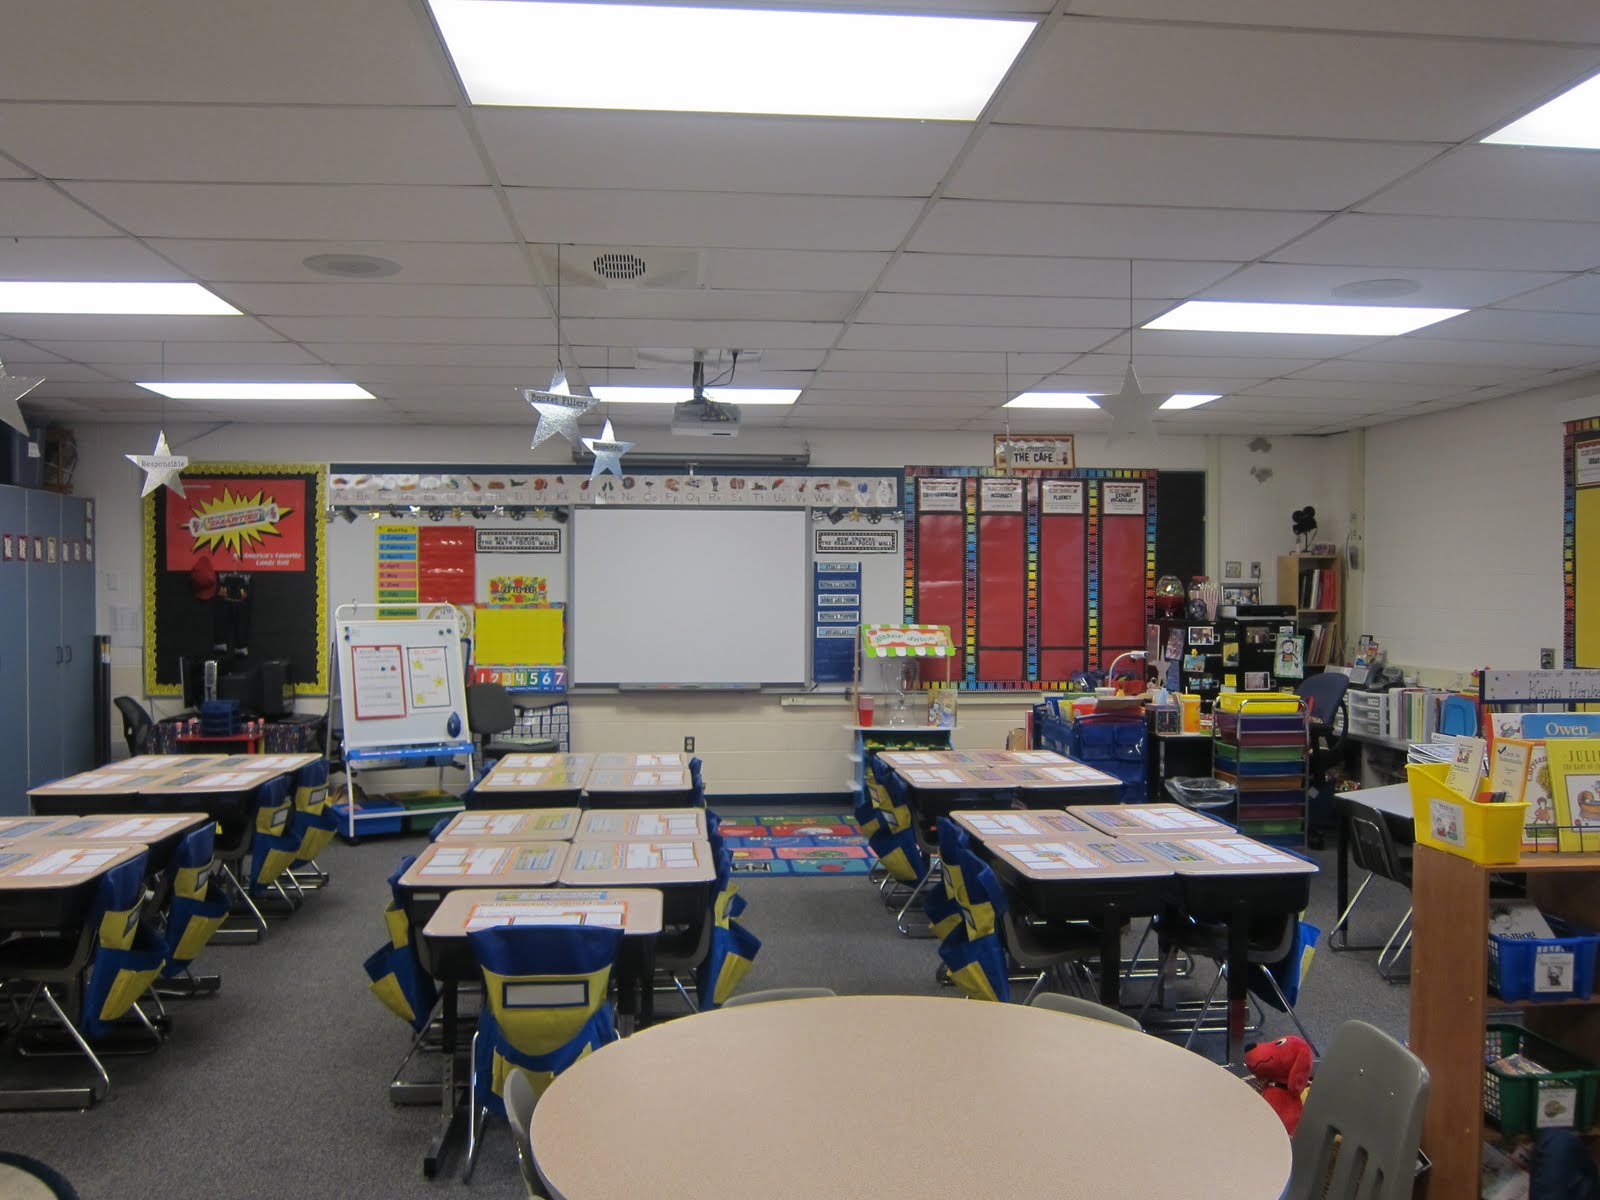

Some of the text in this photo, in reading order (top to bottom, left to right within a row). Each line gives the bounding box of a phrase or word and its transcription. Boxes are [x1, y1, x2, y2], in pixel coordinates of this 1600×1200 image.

[531, 393, 589, 408] Bucket Fillers
[141, 460, 185, 468] Responsible
[1013, 452, 1029, 463] THE
[208, 511, 260, 528] SMARTIES
[500, 586, 538, 594] SEPTEMBER
[480, 672, 485, 683] 1
[491, 672, 499, 683] 2
[504, 672, 512, 685] 3
[529, 672, 538, 685] 5
[542, 672, 551, 685] 6
[555, 672, 564, 685] 7
[1528, 680, 1562, 699] Kevin
[1545, 722, 1590, 736] Owen
[1569, 750, 1600, 762] JULI
